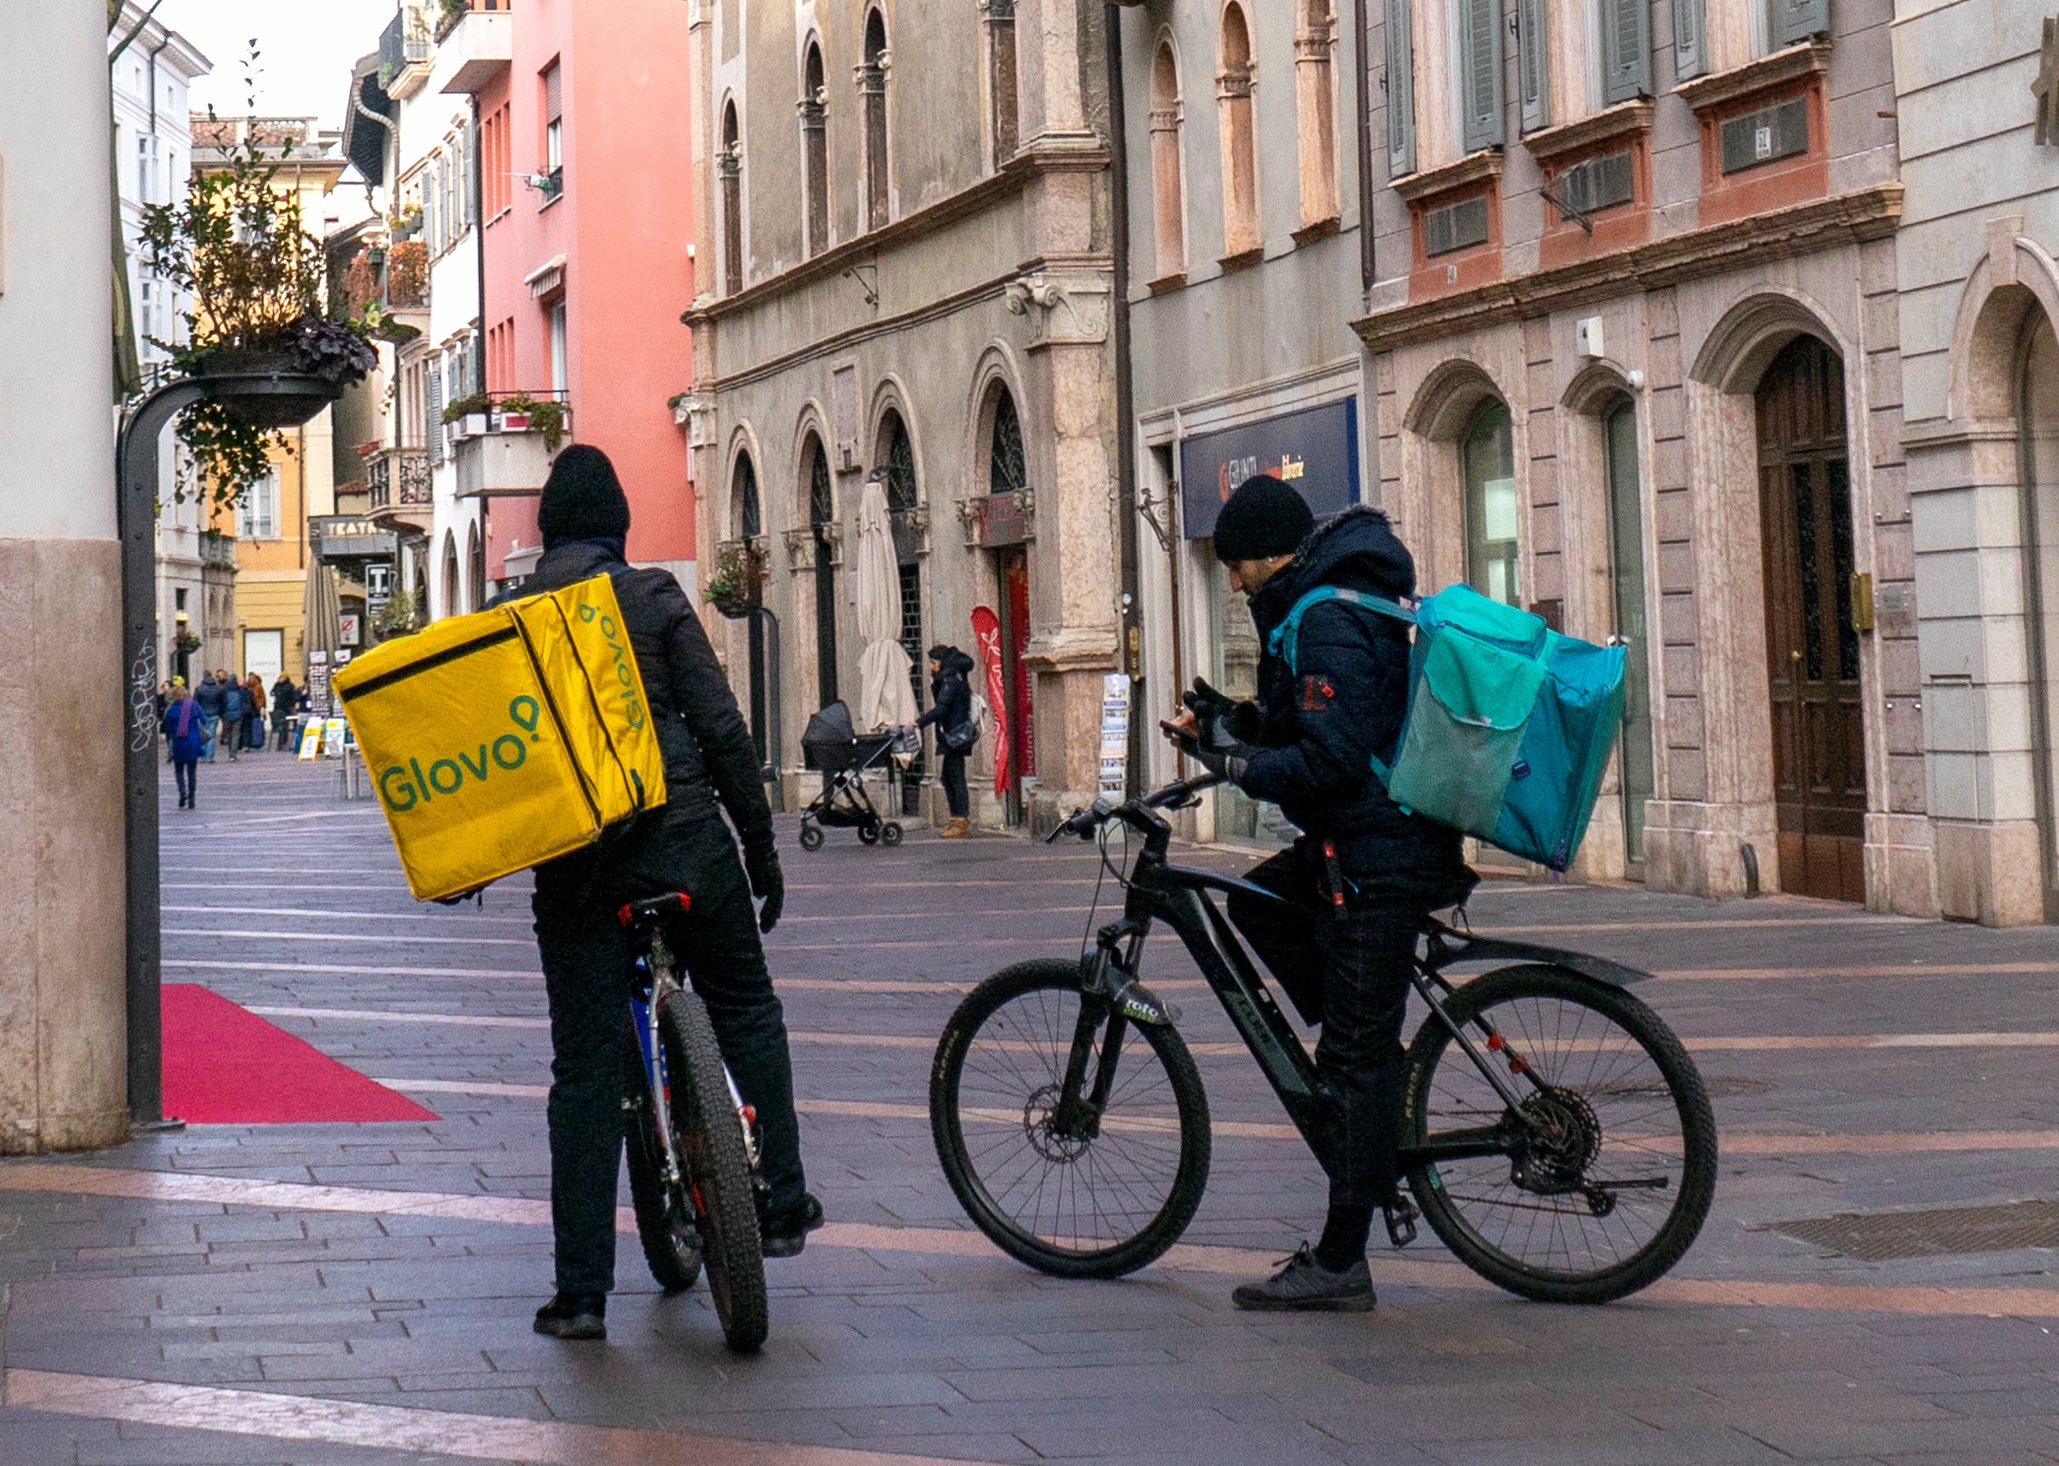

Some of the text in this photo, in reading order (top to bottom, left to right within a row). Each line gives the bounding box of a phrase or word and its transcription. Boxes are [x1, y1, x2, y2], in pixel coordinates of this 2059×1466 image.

[327, 521, 387, 536] TEATR
[600, 614, 645, 729] Glovo
[379, 733, 527, 812] Glovo
